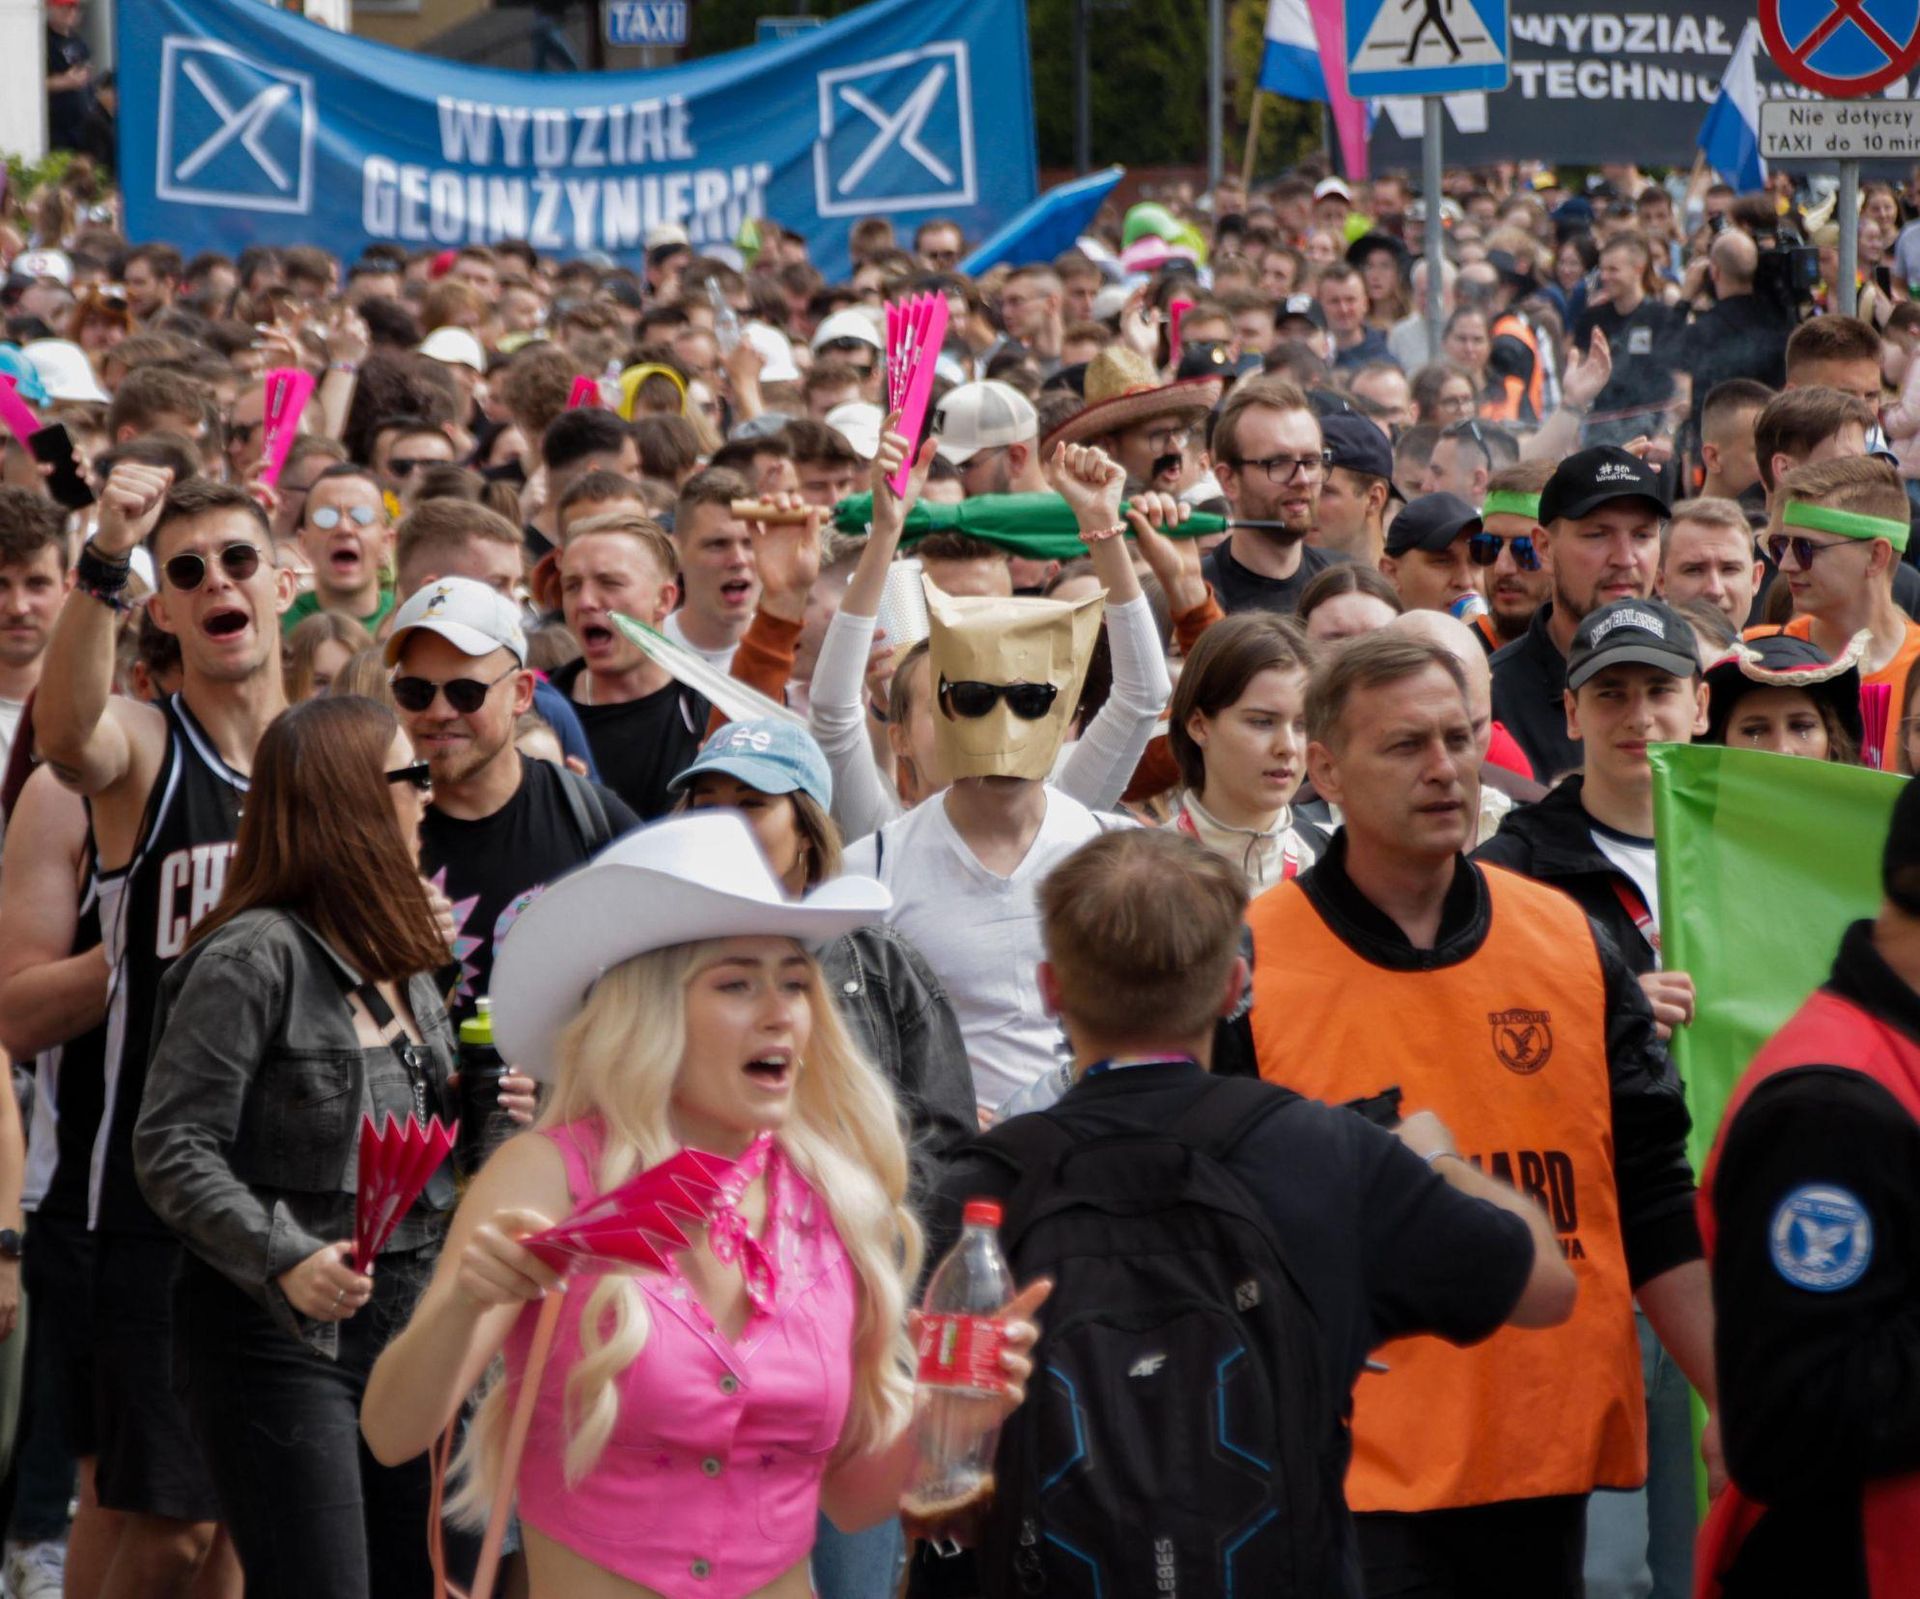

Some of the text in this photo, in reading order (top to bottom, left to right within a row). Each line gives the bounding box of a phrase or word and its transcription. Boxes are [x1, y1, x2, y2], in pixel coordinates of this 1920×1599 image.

[612, 4, 683, 41] TAXI
[1512, 14, 1733, 54] WYDZIAŁ
[437, 94, 697, 168] WYDZIAŁ
[1789, 106, 1913, 128] Nie dotyczy
[1767, 135, 1812, 151] TAXI
[1826, 134, 1850, 151] do
[1864, 135, 1883, 150] 10
[156, 842, 239, 959] CH
